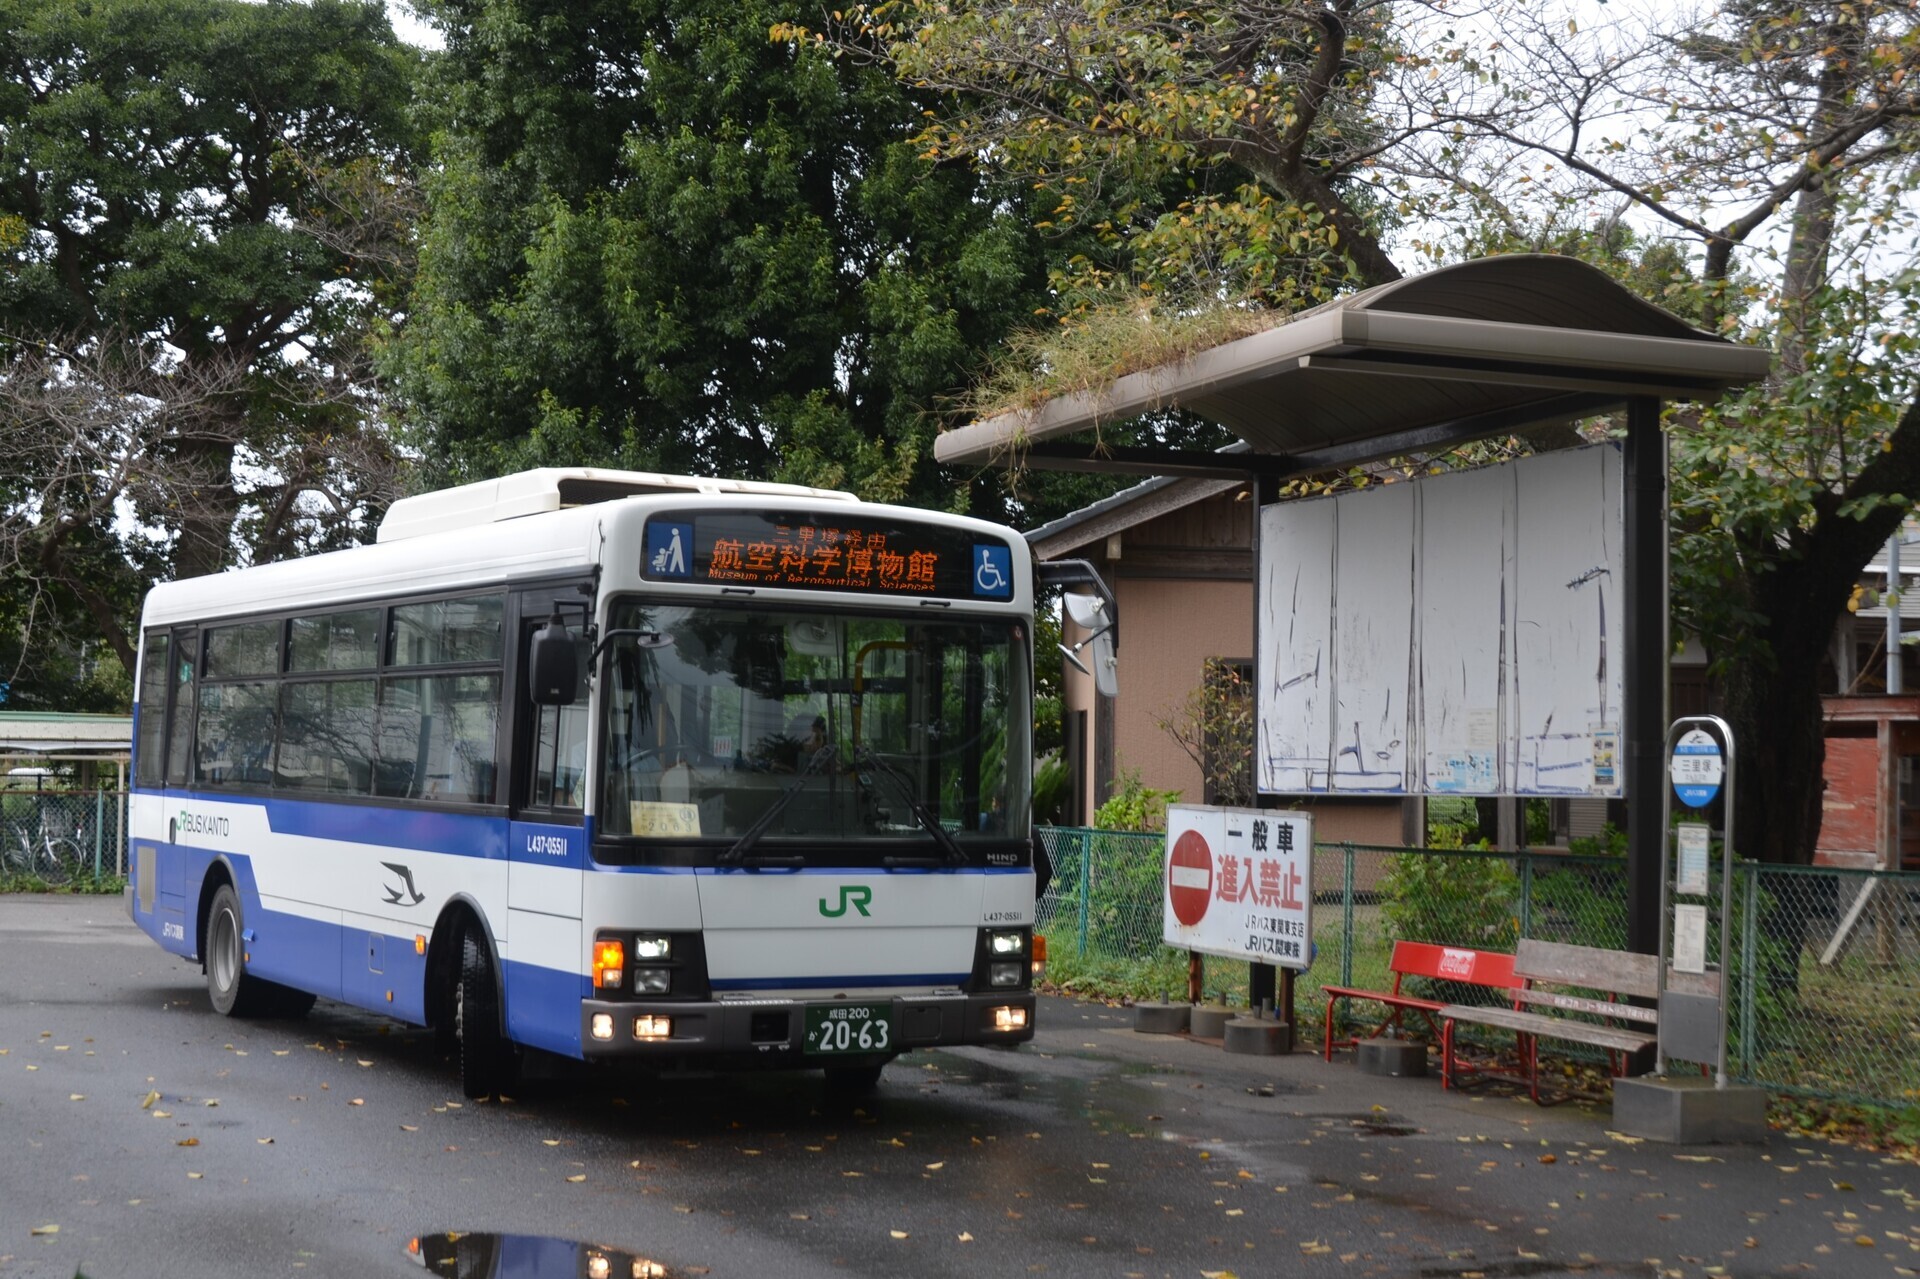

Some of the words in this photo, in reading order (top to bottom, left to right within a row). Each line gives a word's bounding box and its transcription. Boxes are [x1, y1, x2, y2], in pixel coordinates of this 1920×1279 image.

[711, 538, 938, 582] 航空科学博物館
[708, 569, 758, 581] Museum
[788, 573, 871, 588] Aeronautical
[880, 579, 936, 592] Sciences
[176, 810, 187, 832] JR
[527, 834, 568, 857] L437-05511
[1228, 819, 1294, 854] 一般車
[987, 853, 1018, 862] HINO
[1216, 854, 1304, 911] 進入禁止
[819, 885, 872, 918] JR
[829, 1008, 847, 1020] 成田
[848, 1008, 869, 1020] 200
[820, 1019, 889, 1051] 20-63
